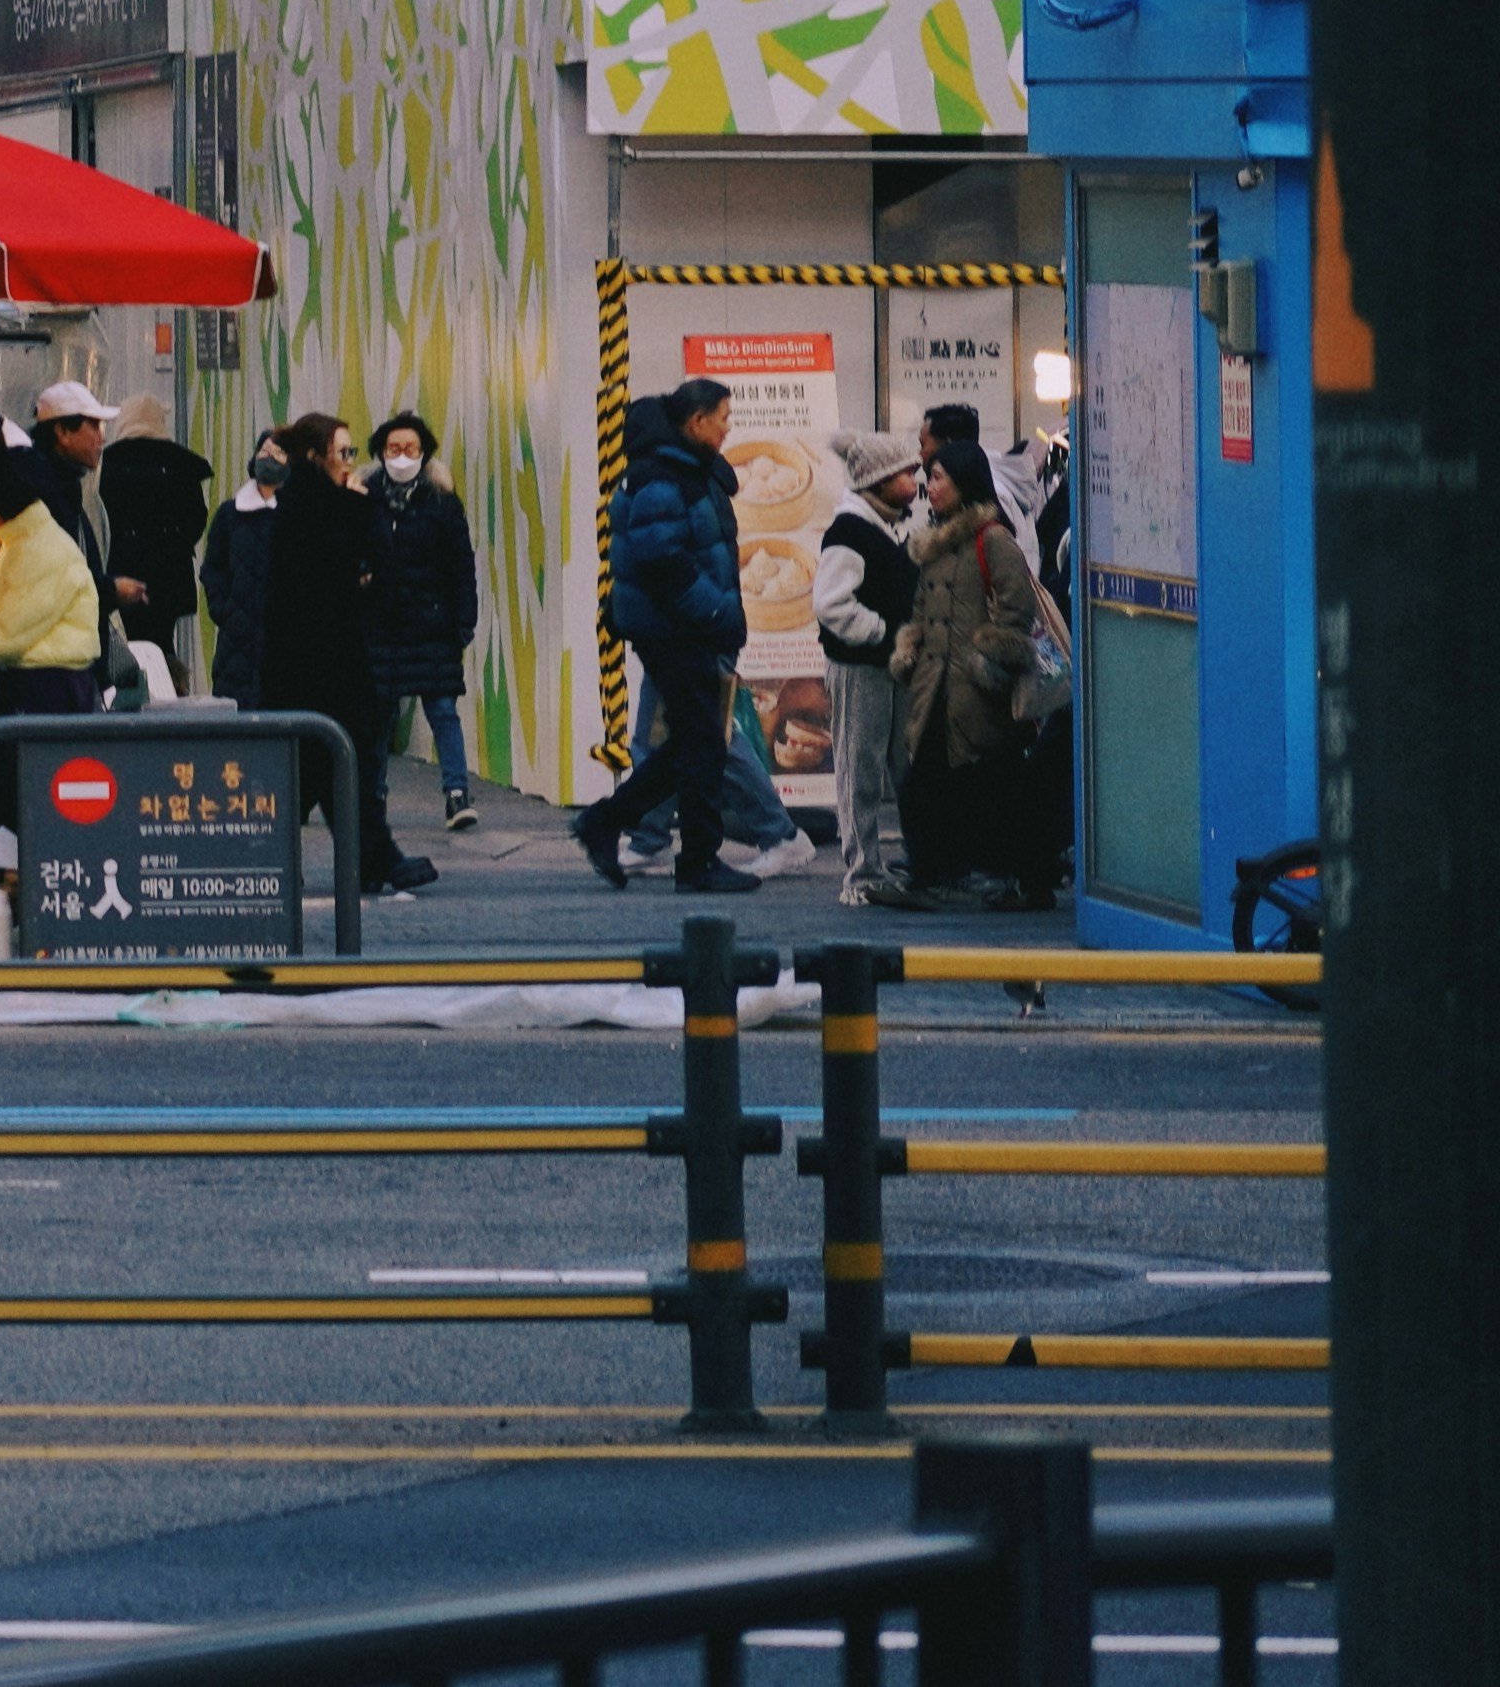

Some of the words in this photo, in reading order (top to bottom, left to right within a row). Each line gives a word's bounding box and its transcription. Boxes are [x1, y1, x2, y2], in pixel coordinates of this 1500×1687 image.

[741, 341, 814, 356] DimDimSum
[39, 859, 91, 889] 걷자,
[140, 877, 174, 900] 매일
[181, 878, 280, 897] 10:00~23:00
[40, 890, 84, 920] 서울
